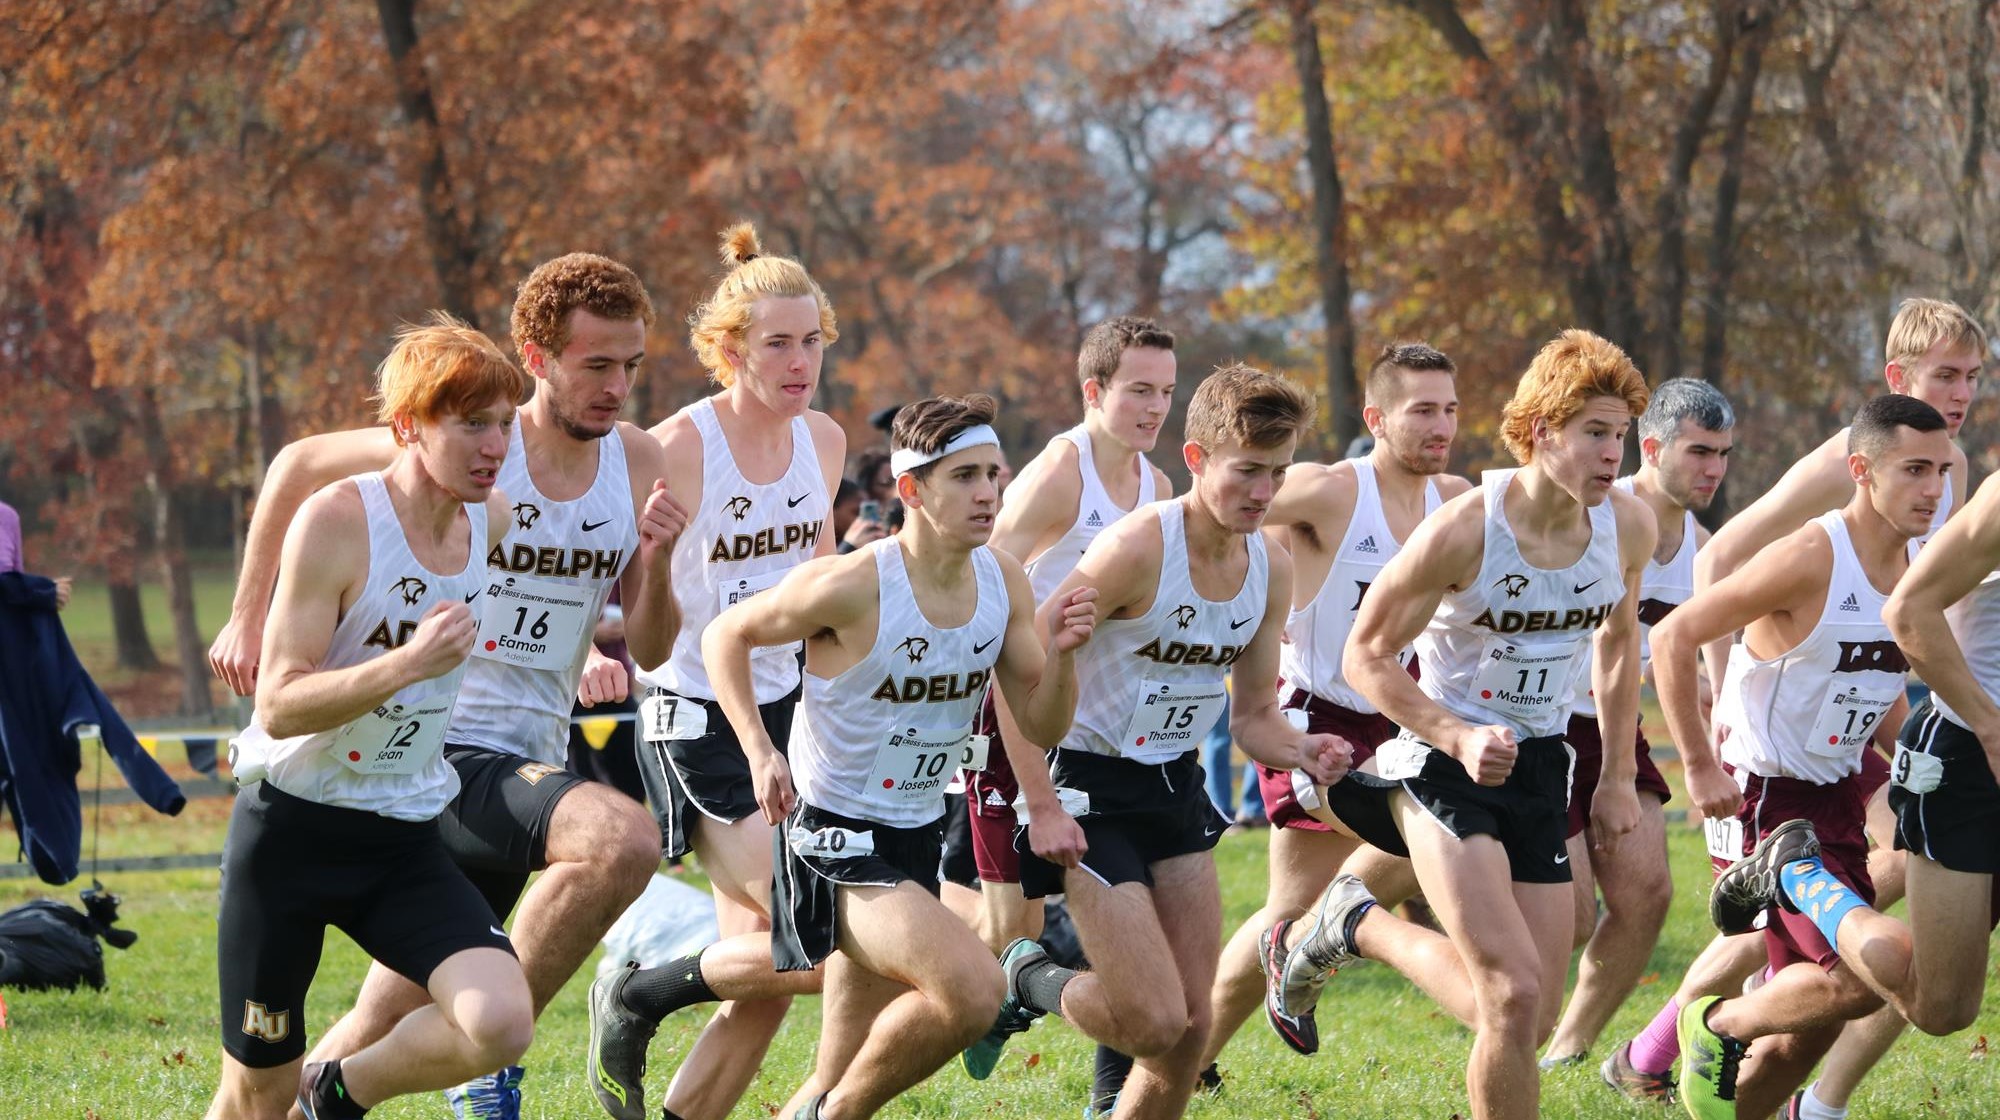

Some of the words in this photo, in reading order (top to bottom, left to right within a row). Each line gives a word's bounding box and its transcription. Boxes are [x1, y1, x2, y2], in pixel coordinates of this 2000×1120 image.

[1355, 545, 1379, 554] adidas
[501, 589, 520, 599] CROSS
[520, 593, 545, 603] COUNTRY
[544, 597, 584, 608] CHAMPIONSHIPS
[514, 606, 550, 640] 16
[498, 635, 546, 654] Eamon
[504, 652, 534, 663] Adelphi
[1517, 668, 1548, 693] 11
[1496, 689, 1554, 706] Matthew
[654, 699, 679, 735] 17
[1163, 705, 1200, 730] 15
[384, 720, 420, 749] 12
[902, 738, 920, 747] CROSS
[1148, 731, 1191, 741] Thomas
[375, 749, 403, 761] Sean
[913, 752, 948, 779] 10
[898, 778, 940, 791] Joseph
[813, 830, 847, 853] 10
[1710, 819, 1731, 854] 197
[242, 999, 290, 1043] AU
